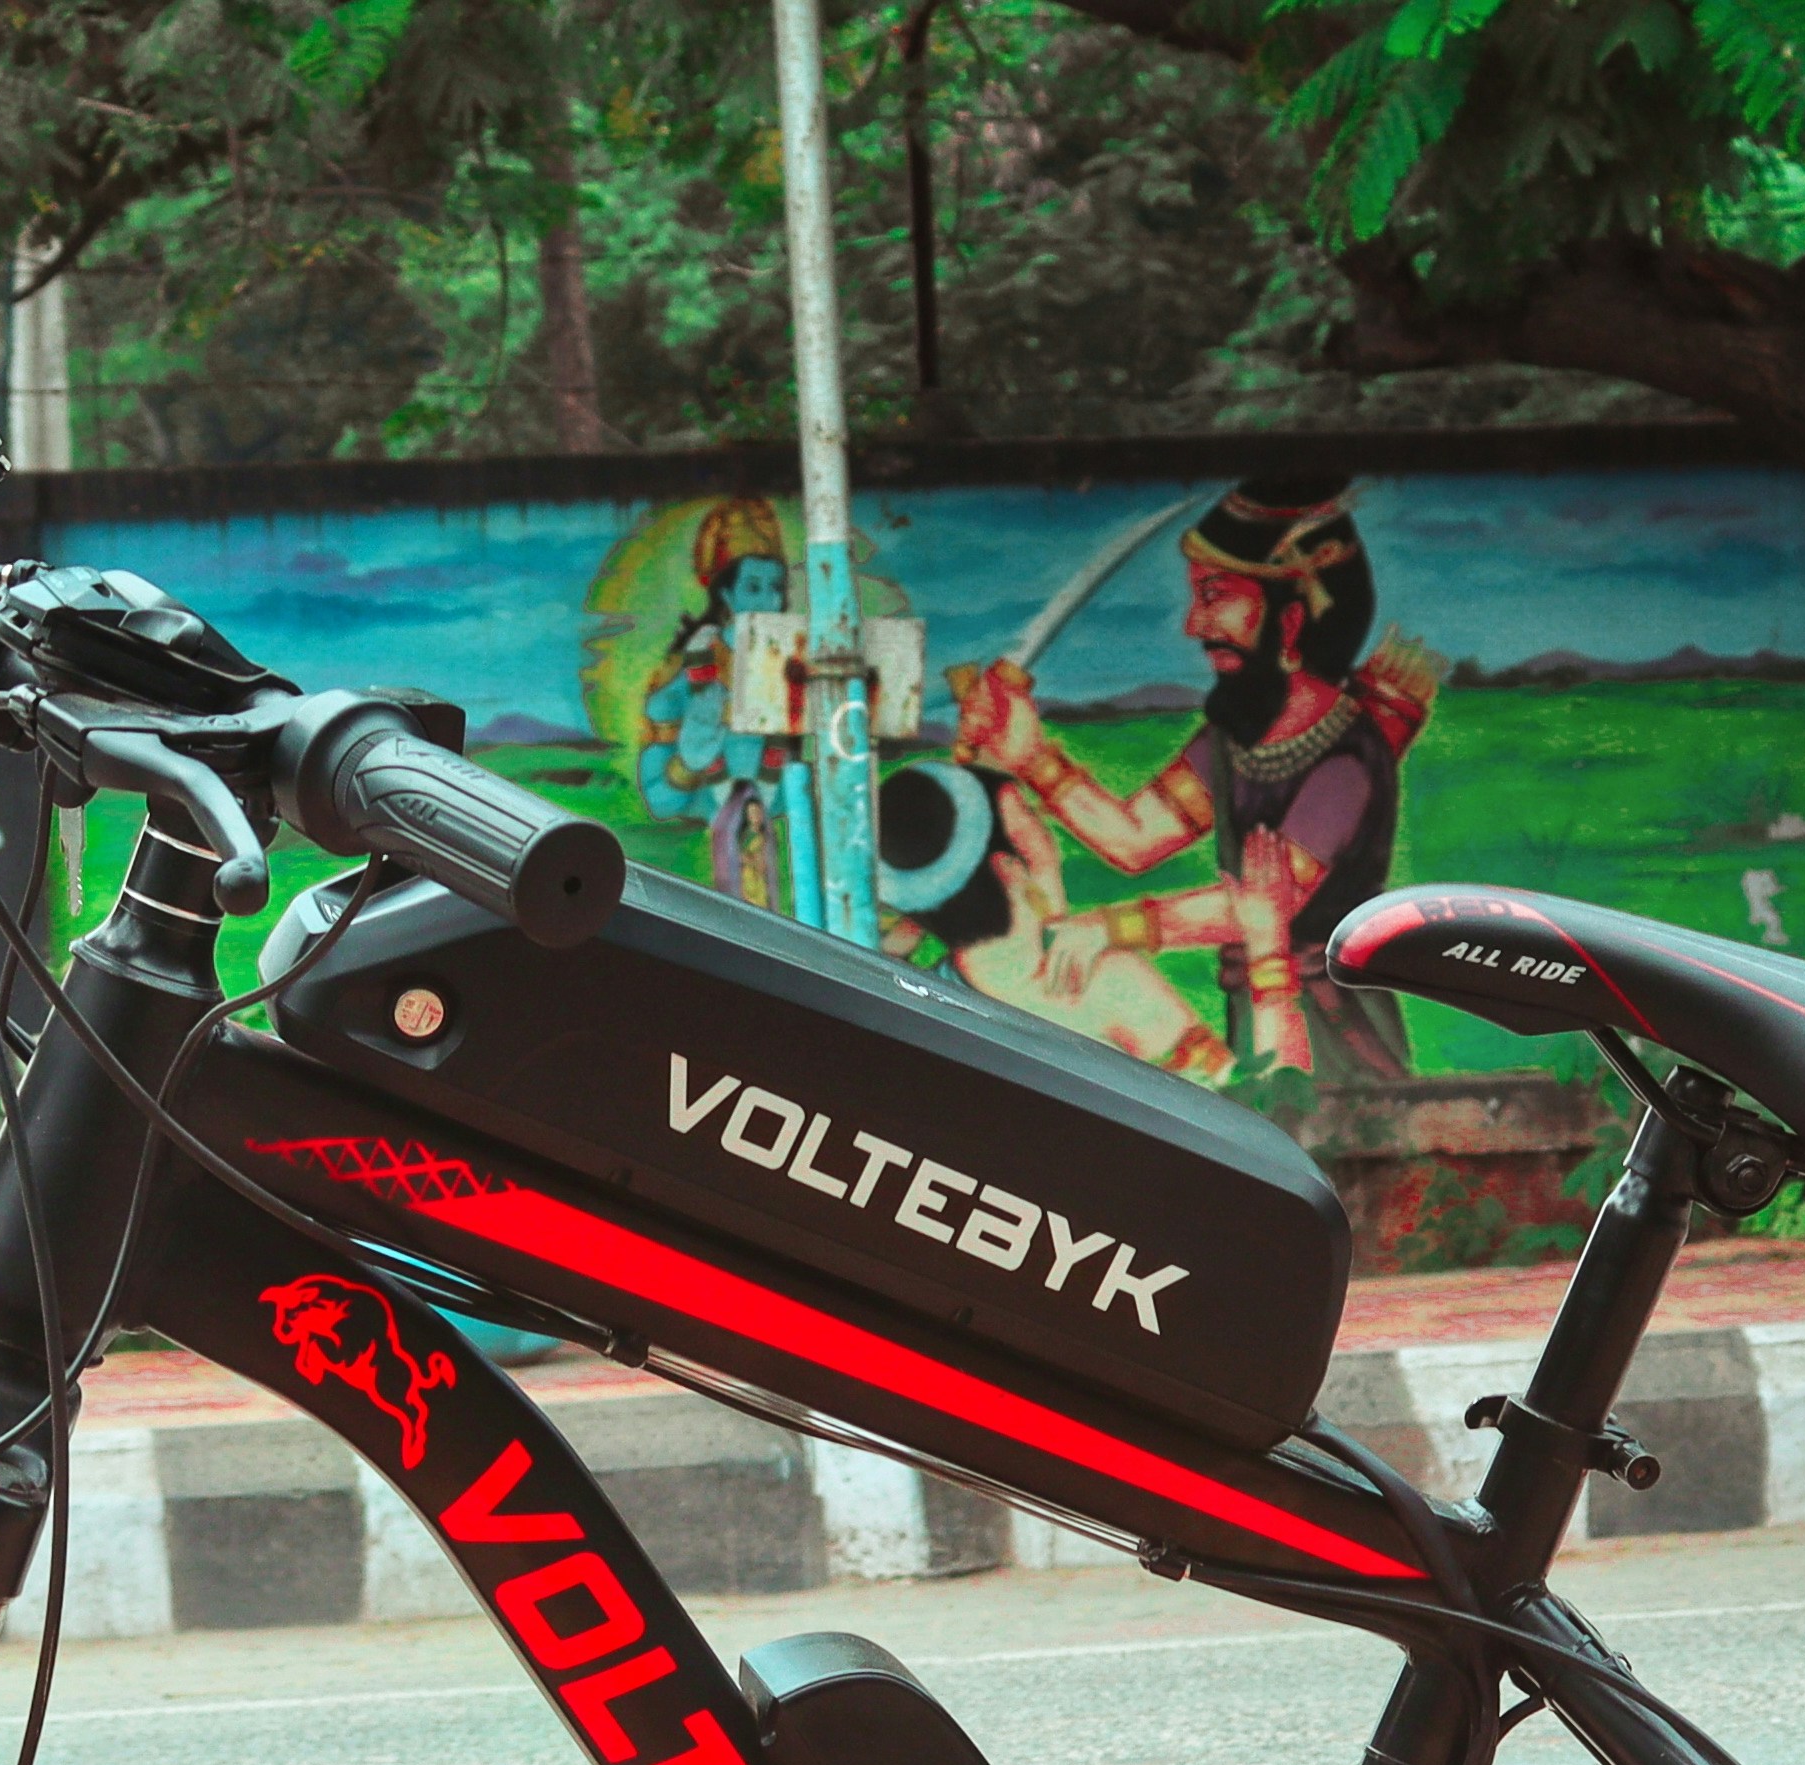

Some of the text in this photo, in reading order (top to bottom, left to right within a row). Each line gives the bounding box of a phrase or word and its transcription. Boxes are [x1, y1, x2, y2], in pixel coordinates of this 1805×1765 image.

[1442, 941, 1586, 985] ALL RIDE
[669, 1052, 1190, 1336] VOLTEBYK
